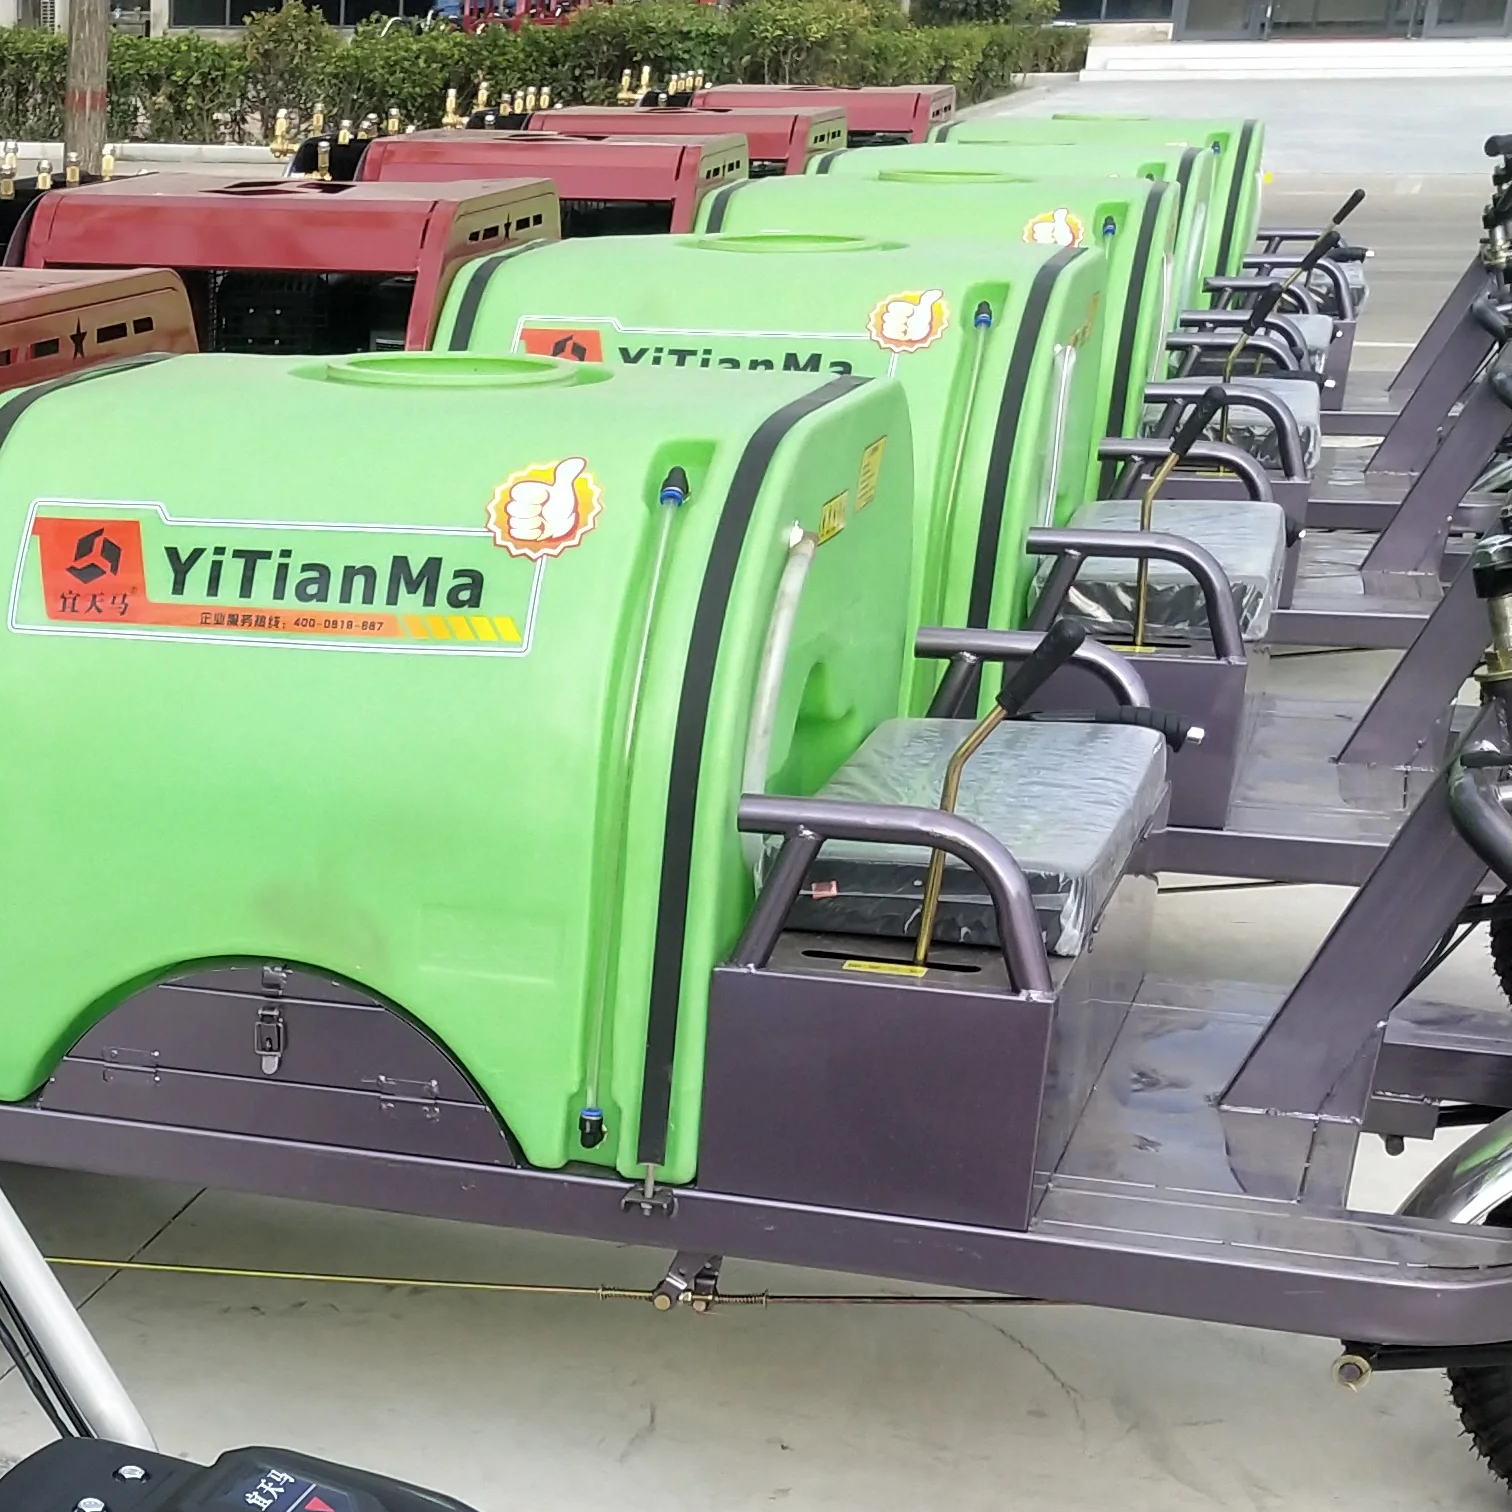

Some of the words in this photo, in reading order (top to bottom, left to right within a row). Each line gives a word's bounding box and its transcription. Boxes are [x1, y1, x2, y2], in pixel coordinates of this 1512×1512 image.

[163, 546, 485, 609] YiTianMa
[59, 590, 130, 617] 宜天马
[244, 1469, 295, 1512] 宜天马
